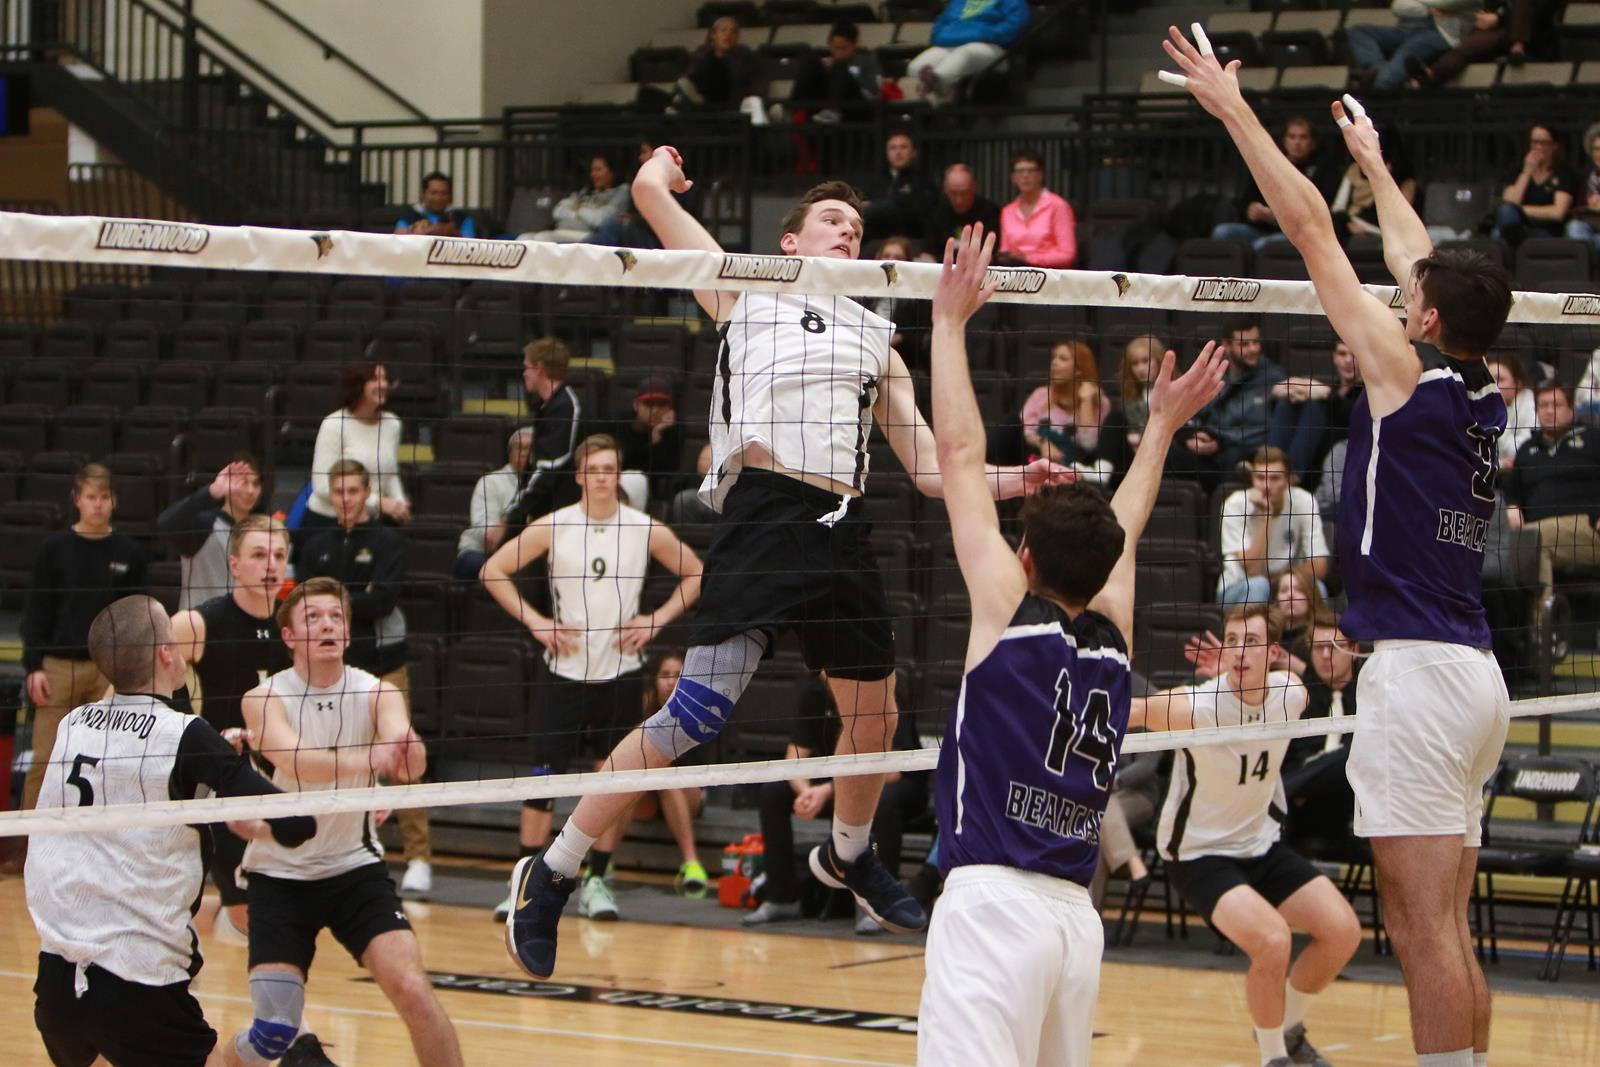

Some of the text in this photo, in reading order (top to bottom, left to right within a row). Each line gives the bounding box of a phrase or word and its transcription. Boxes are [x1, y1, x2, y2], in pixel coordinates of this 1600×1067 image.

[97, 221, 209, 254] LINDENWOOD
[427, 239, 527, 268] LINDENWOOD
[718, 255, 803, 282] LINDENWOOD
[980, 269, 1046, 293] NDENWOOD
[1192, 279, 1261, 302] LINDENWOOD
[800, 310, 826, 334] 8
[591, 556, 606, 582] 9
[1045, 667, 1117, 791] 14
[66, 753, 101, 807] 5
[1238, 750, 1269, 785] 14
[1514, 769, 1580, 792] LINDENWOOD
[1005, 780, 1105, 845] BEARCA
